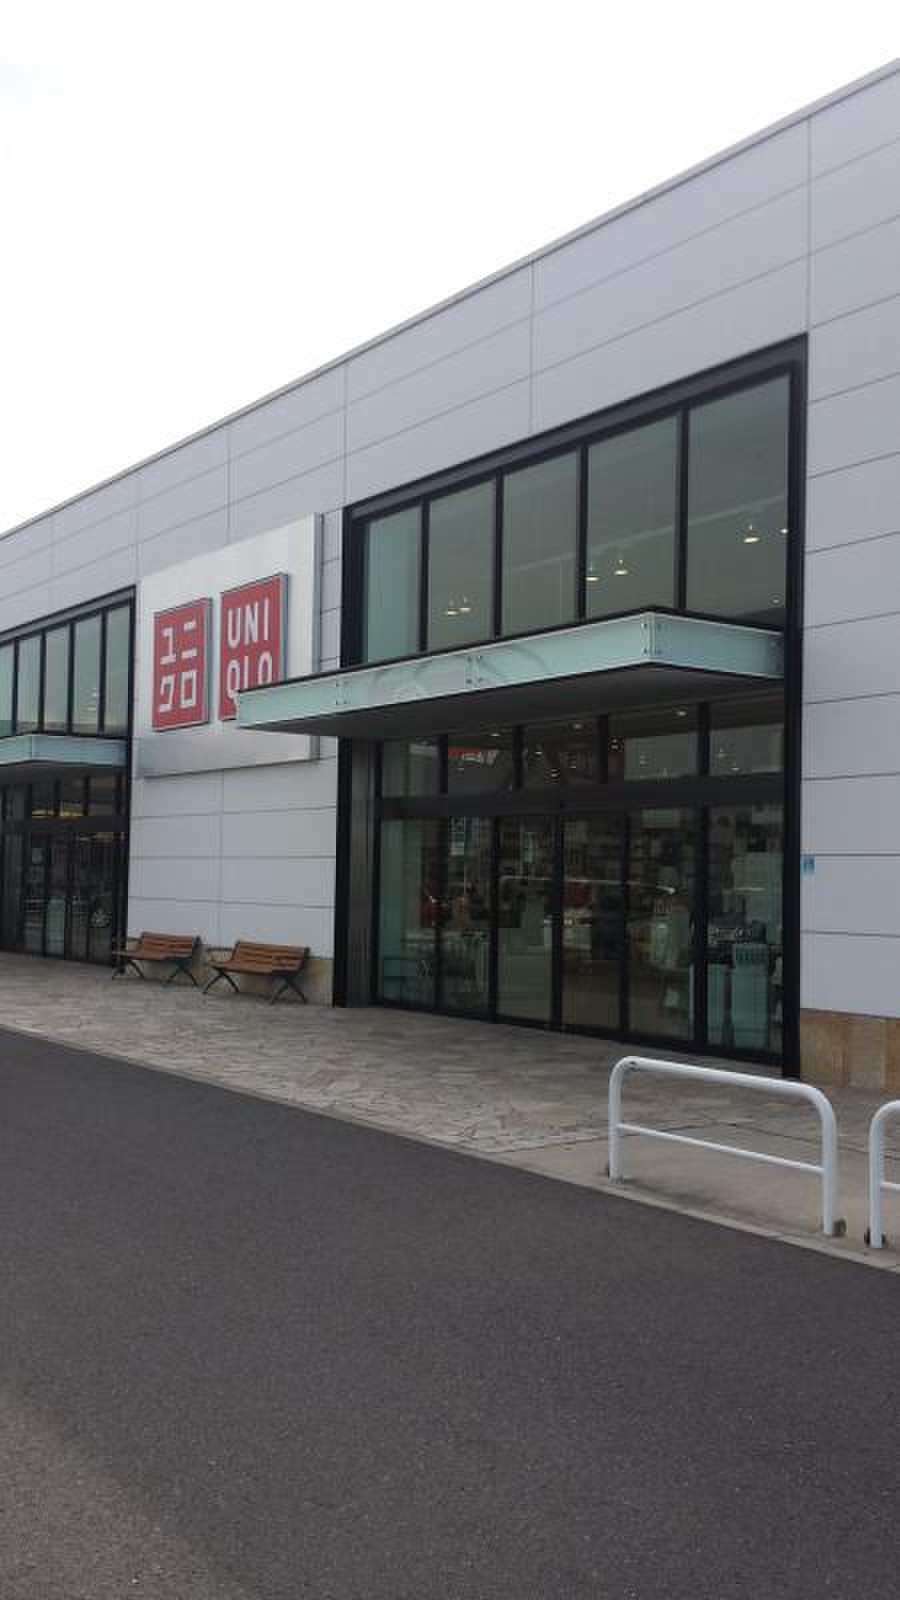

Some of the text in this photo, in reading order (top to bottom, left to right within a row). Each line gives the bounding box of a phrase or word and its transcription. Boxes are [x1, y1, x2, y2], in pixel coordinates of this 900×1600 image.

[160, 620, 197, 665] ユニ
[228, 598, 270, 648] UNI
[159, 669, 197, 713] クロ
